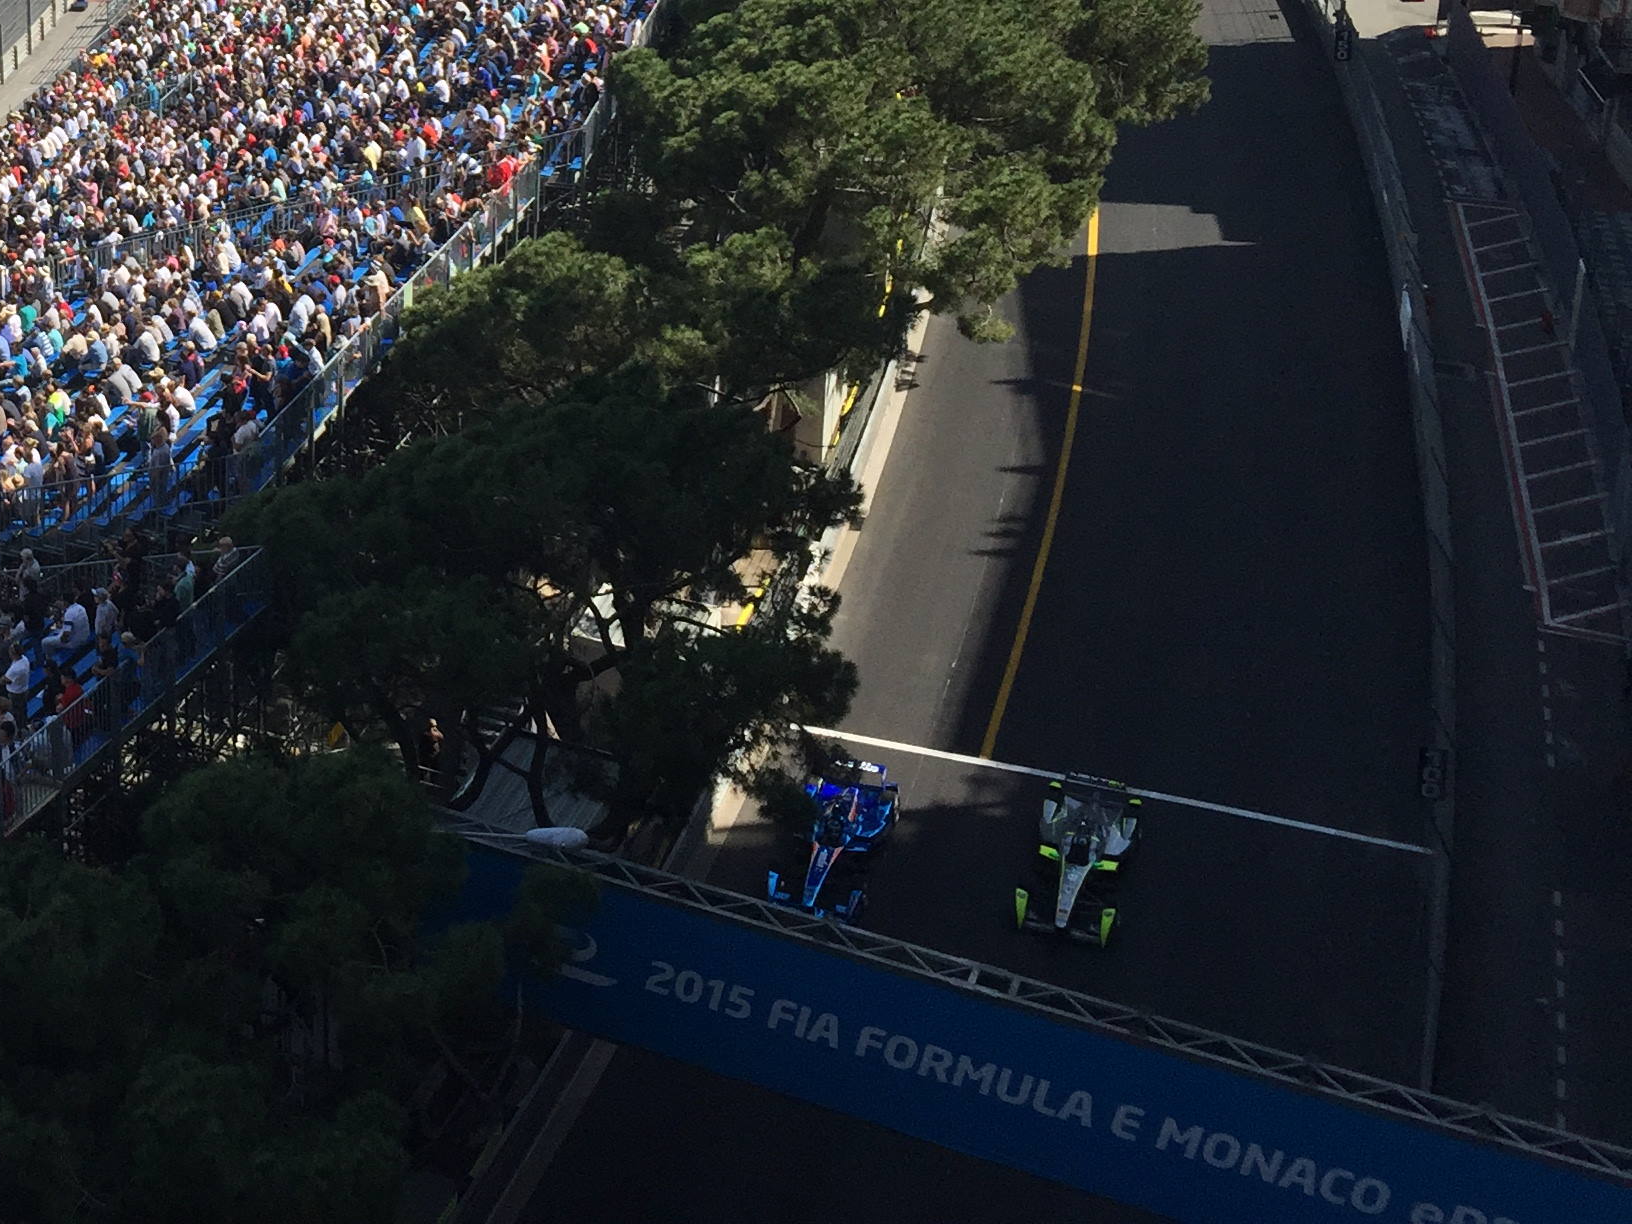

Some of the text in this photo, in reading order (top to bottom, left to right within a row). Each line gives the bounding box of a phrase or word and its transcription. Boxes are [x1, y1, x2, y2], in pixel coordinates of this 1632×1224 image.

[645, 961, 756, 1019] 2015
[768, 998, 839, 1049] FIA
[856, 1026, 1093, 1128] FORMULA
[1111, 1105, 1146, 1141] E
[1155, 1116, 1392, 1214] MONACO
